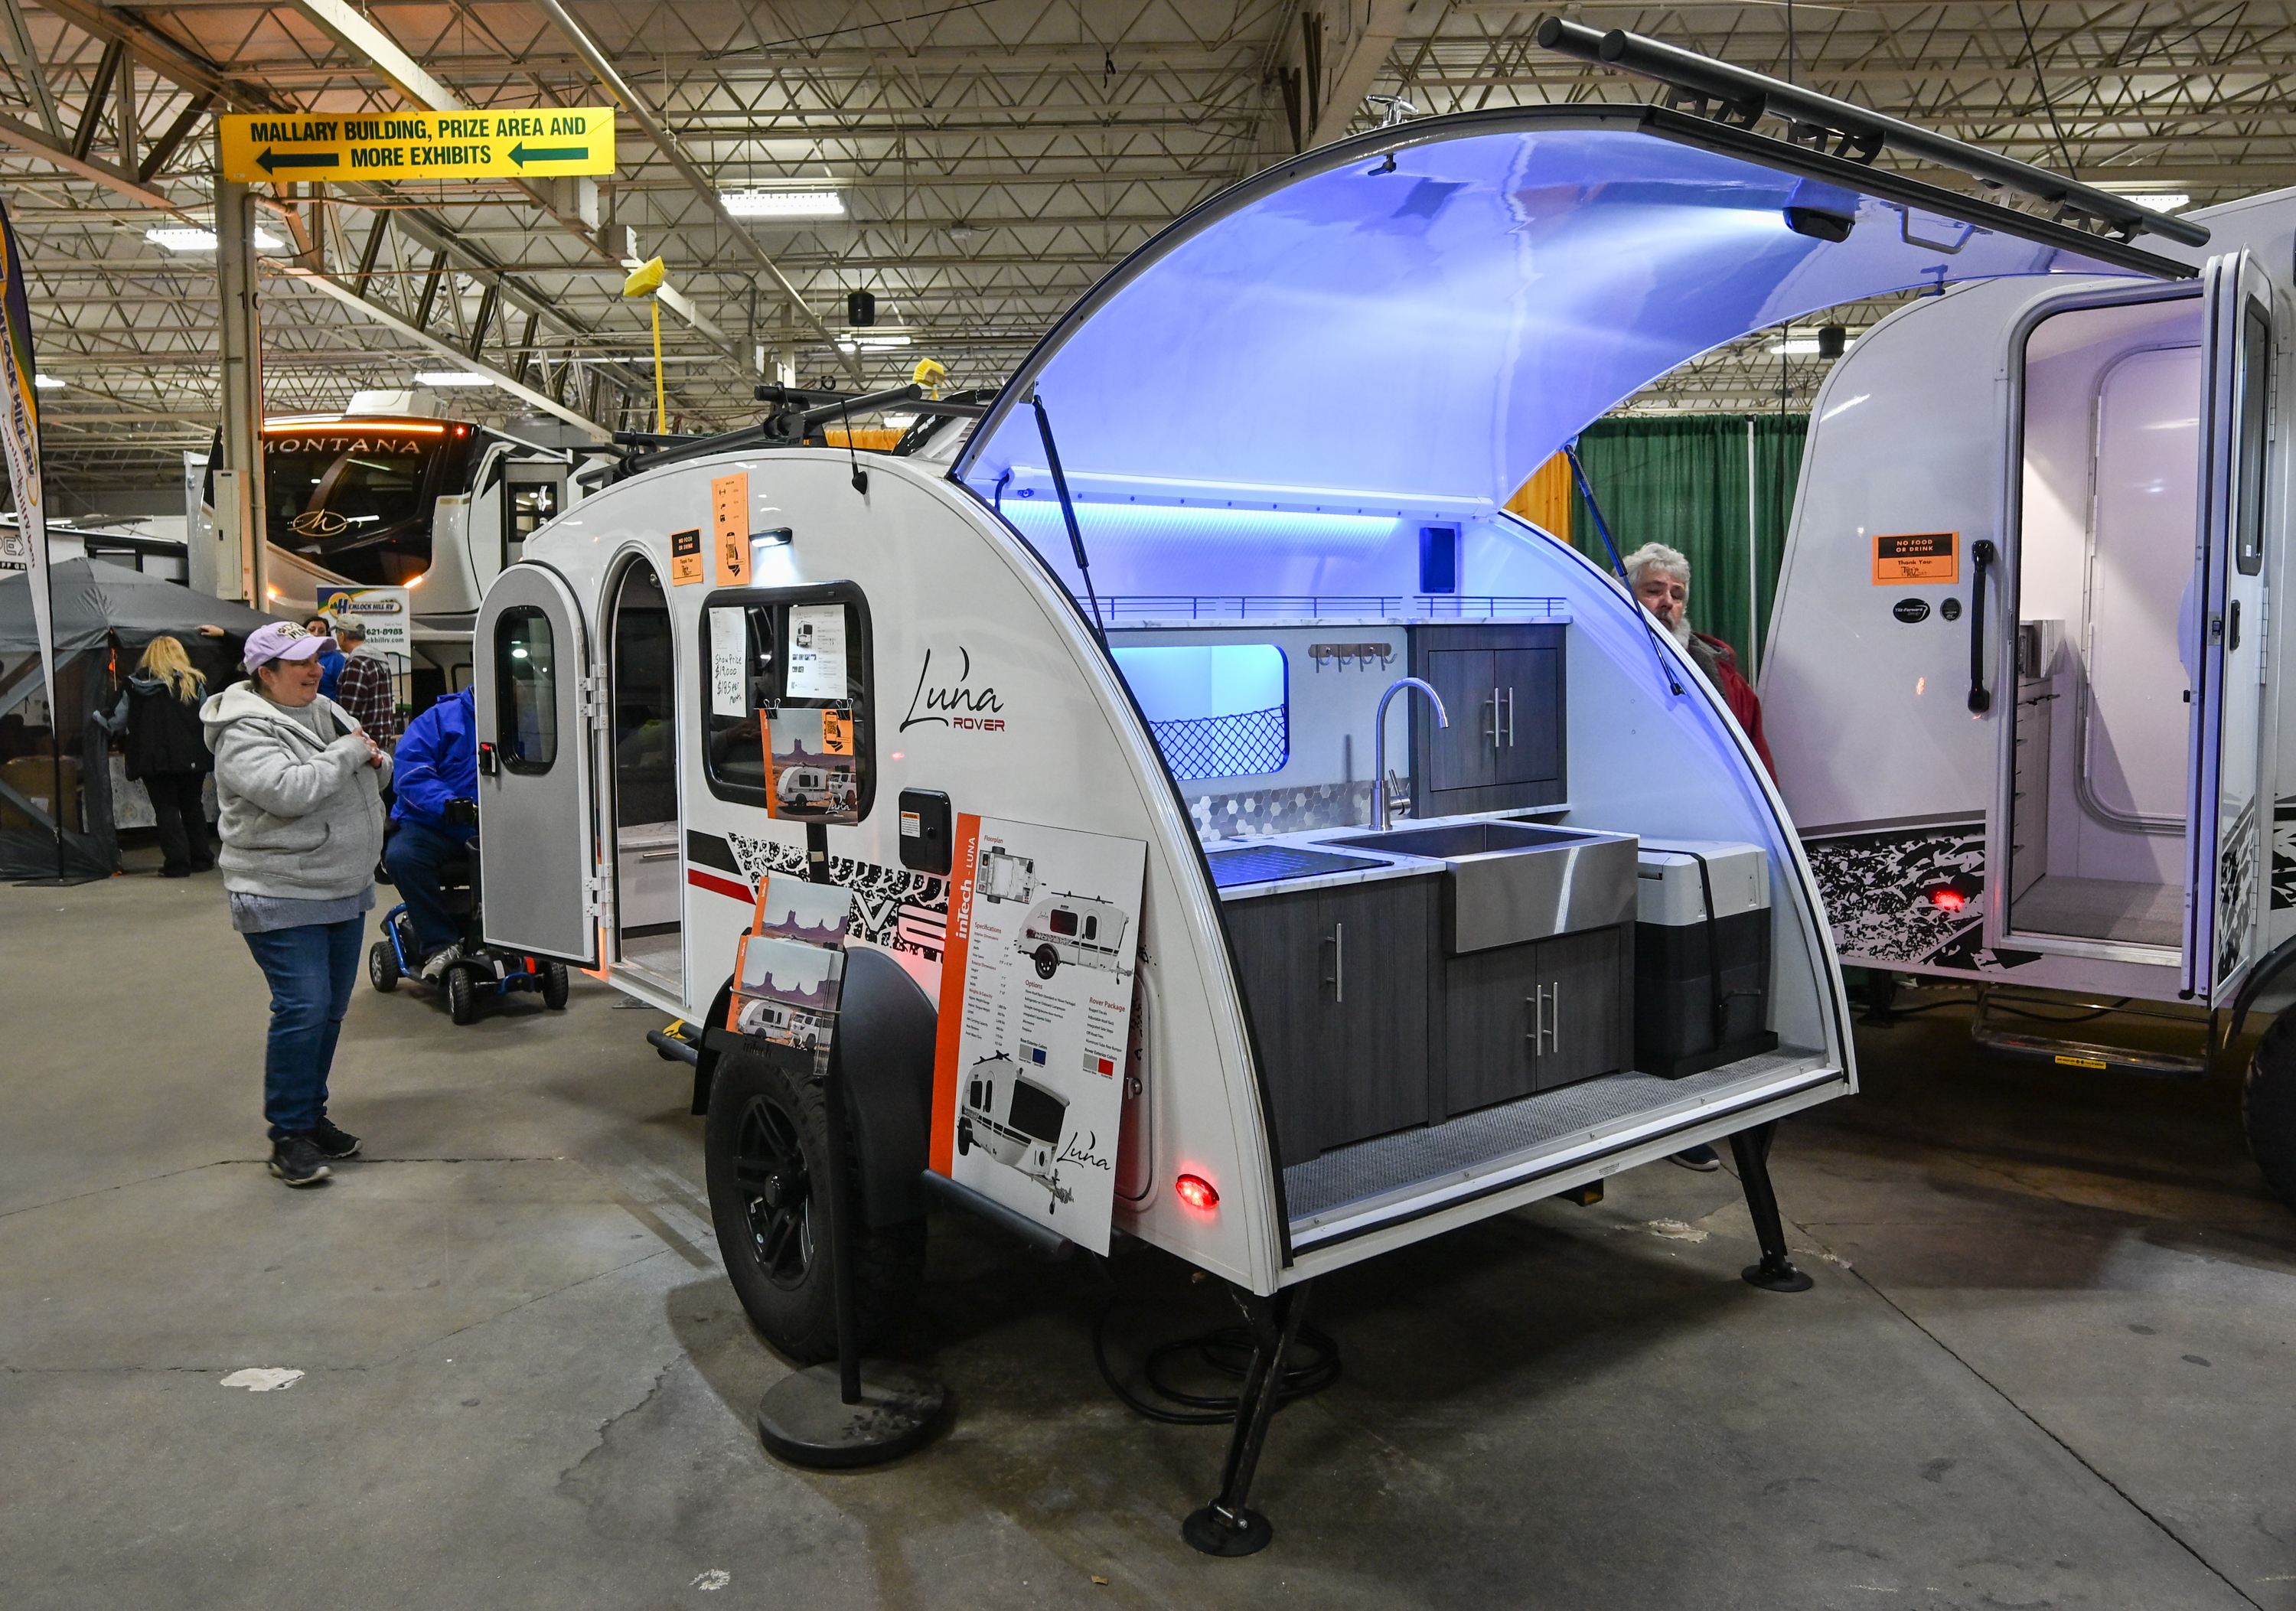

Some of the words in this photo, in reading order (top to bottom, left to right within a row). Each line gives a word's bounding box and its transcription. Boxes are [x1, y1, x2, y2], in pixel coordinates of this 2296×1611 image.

[251, 121, 337, 142] MALLARY
[344, 119, 432, 142] BUILDING,
[439, 119, 490, 138] PRIZE
[496, 118, 544, 136] AREA
[550, 117, 586, 135] AND
[351, 147, 404, 167] MORE
[410, 145, 491, 165] EXHIBITS
[716, 654, 729, 665] Show
[729, 654, 742, 665] Price
[717, 681, 731, 696] $185
[899, 646, 1004, 733] Luna
[954, 717, 1005, 732] ROVER
[825, 793, 851, 814] Luna
[984, 835, 1003, 844] Floorplan
[955, 879, 972, 938] inTech
[966, 837, 976, 868] LUNA
[974, 921, 1002, 934] Specifications
[1026, 980, 1043, 990] Options
[1089, 996, 1104, 1006] Rover
[1104, 1000, 1126, 1013] Package
[1094, 1049, 1107, 1058] Exterior
[1057, 1130, 1110, 1170] Luna
